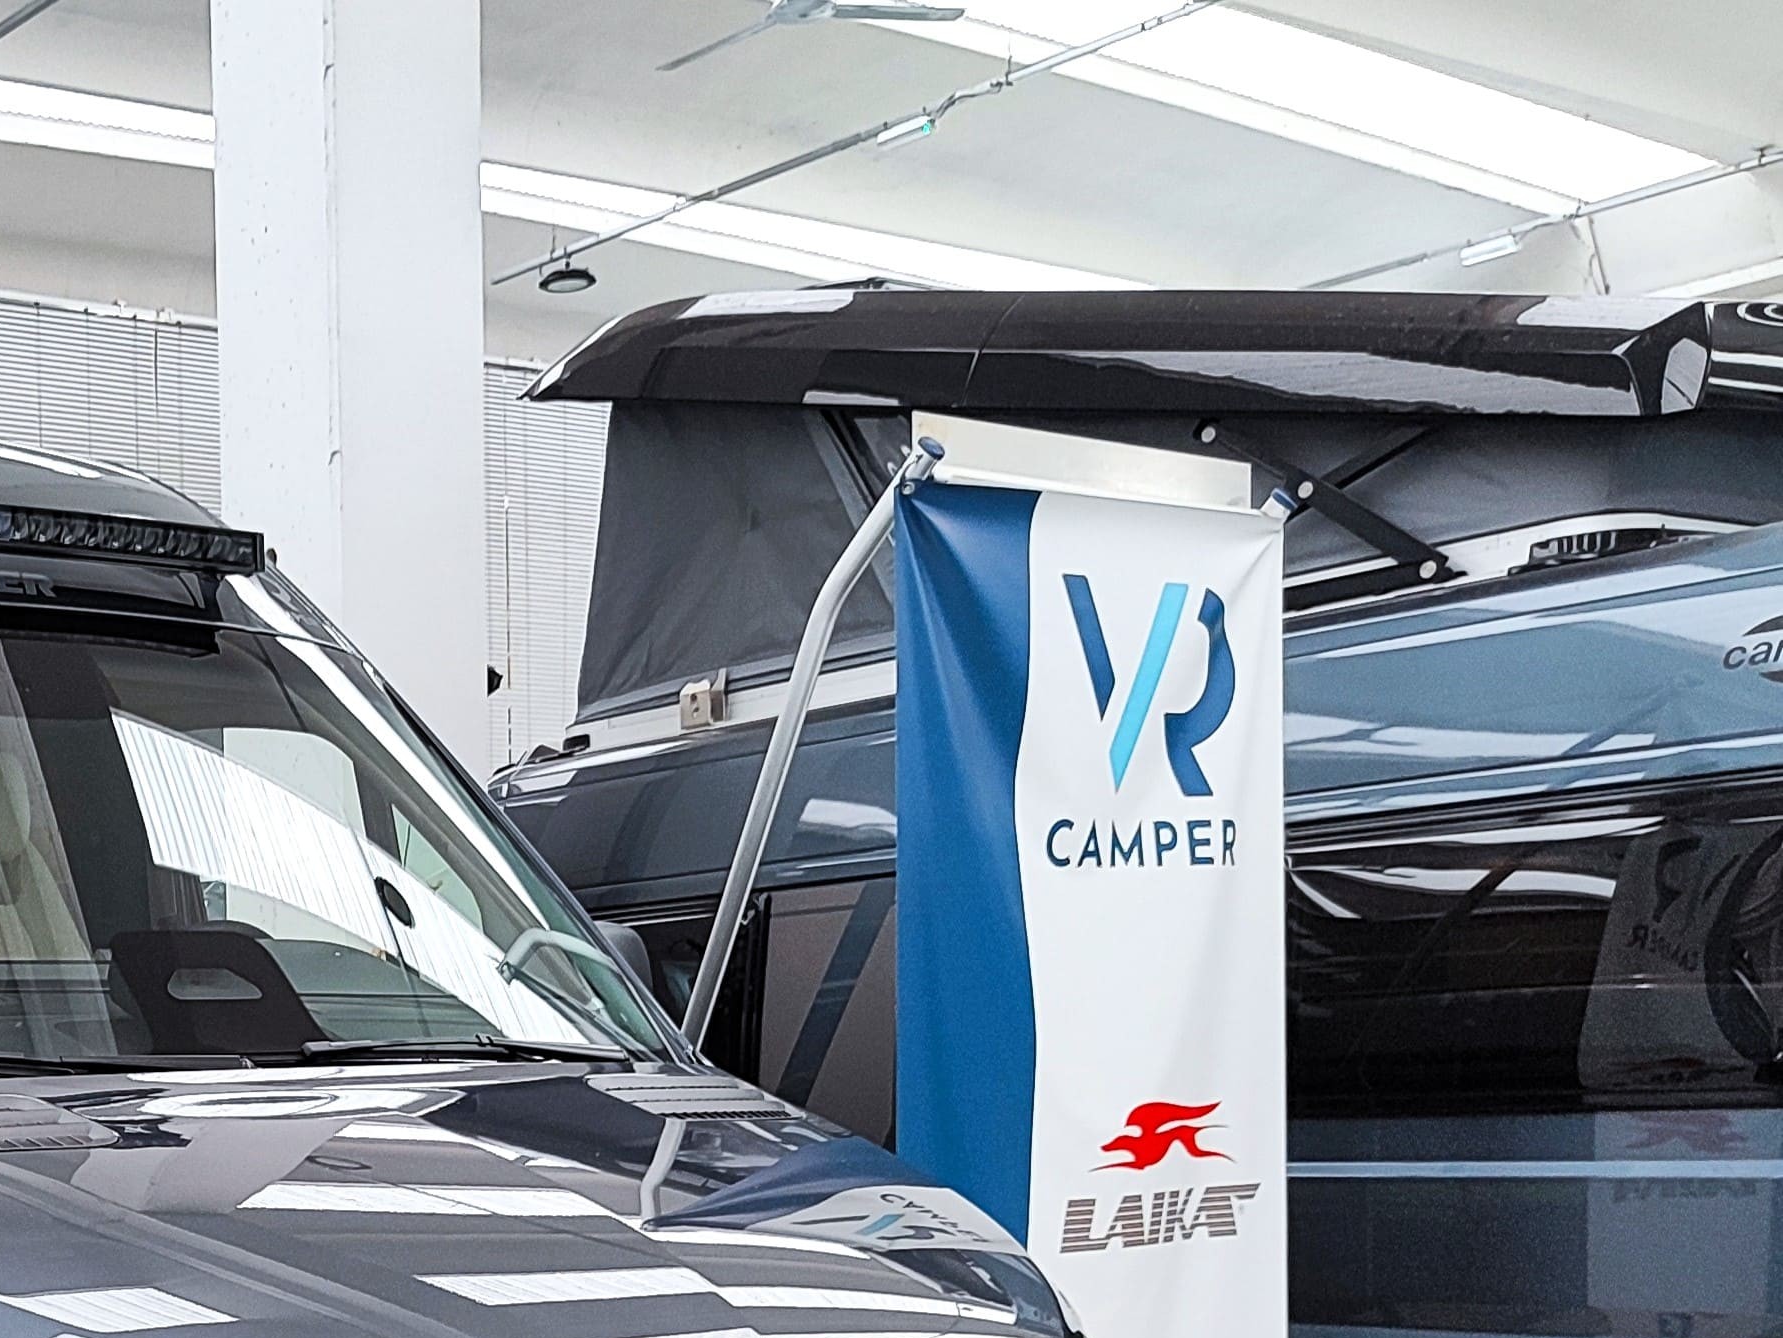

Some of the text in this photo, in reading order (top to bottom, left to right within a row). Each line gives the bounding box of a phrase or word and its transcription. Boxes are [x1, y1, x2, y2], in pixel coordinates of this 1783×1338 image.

[1061, 573, 1236, 797] VR
[1046, 818, 1237, 868] CAMPER
[1059, 1182, 1262, 1254] LAIKA
